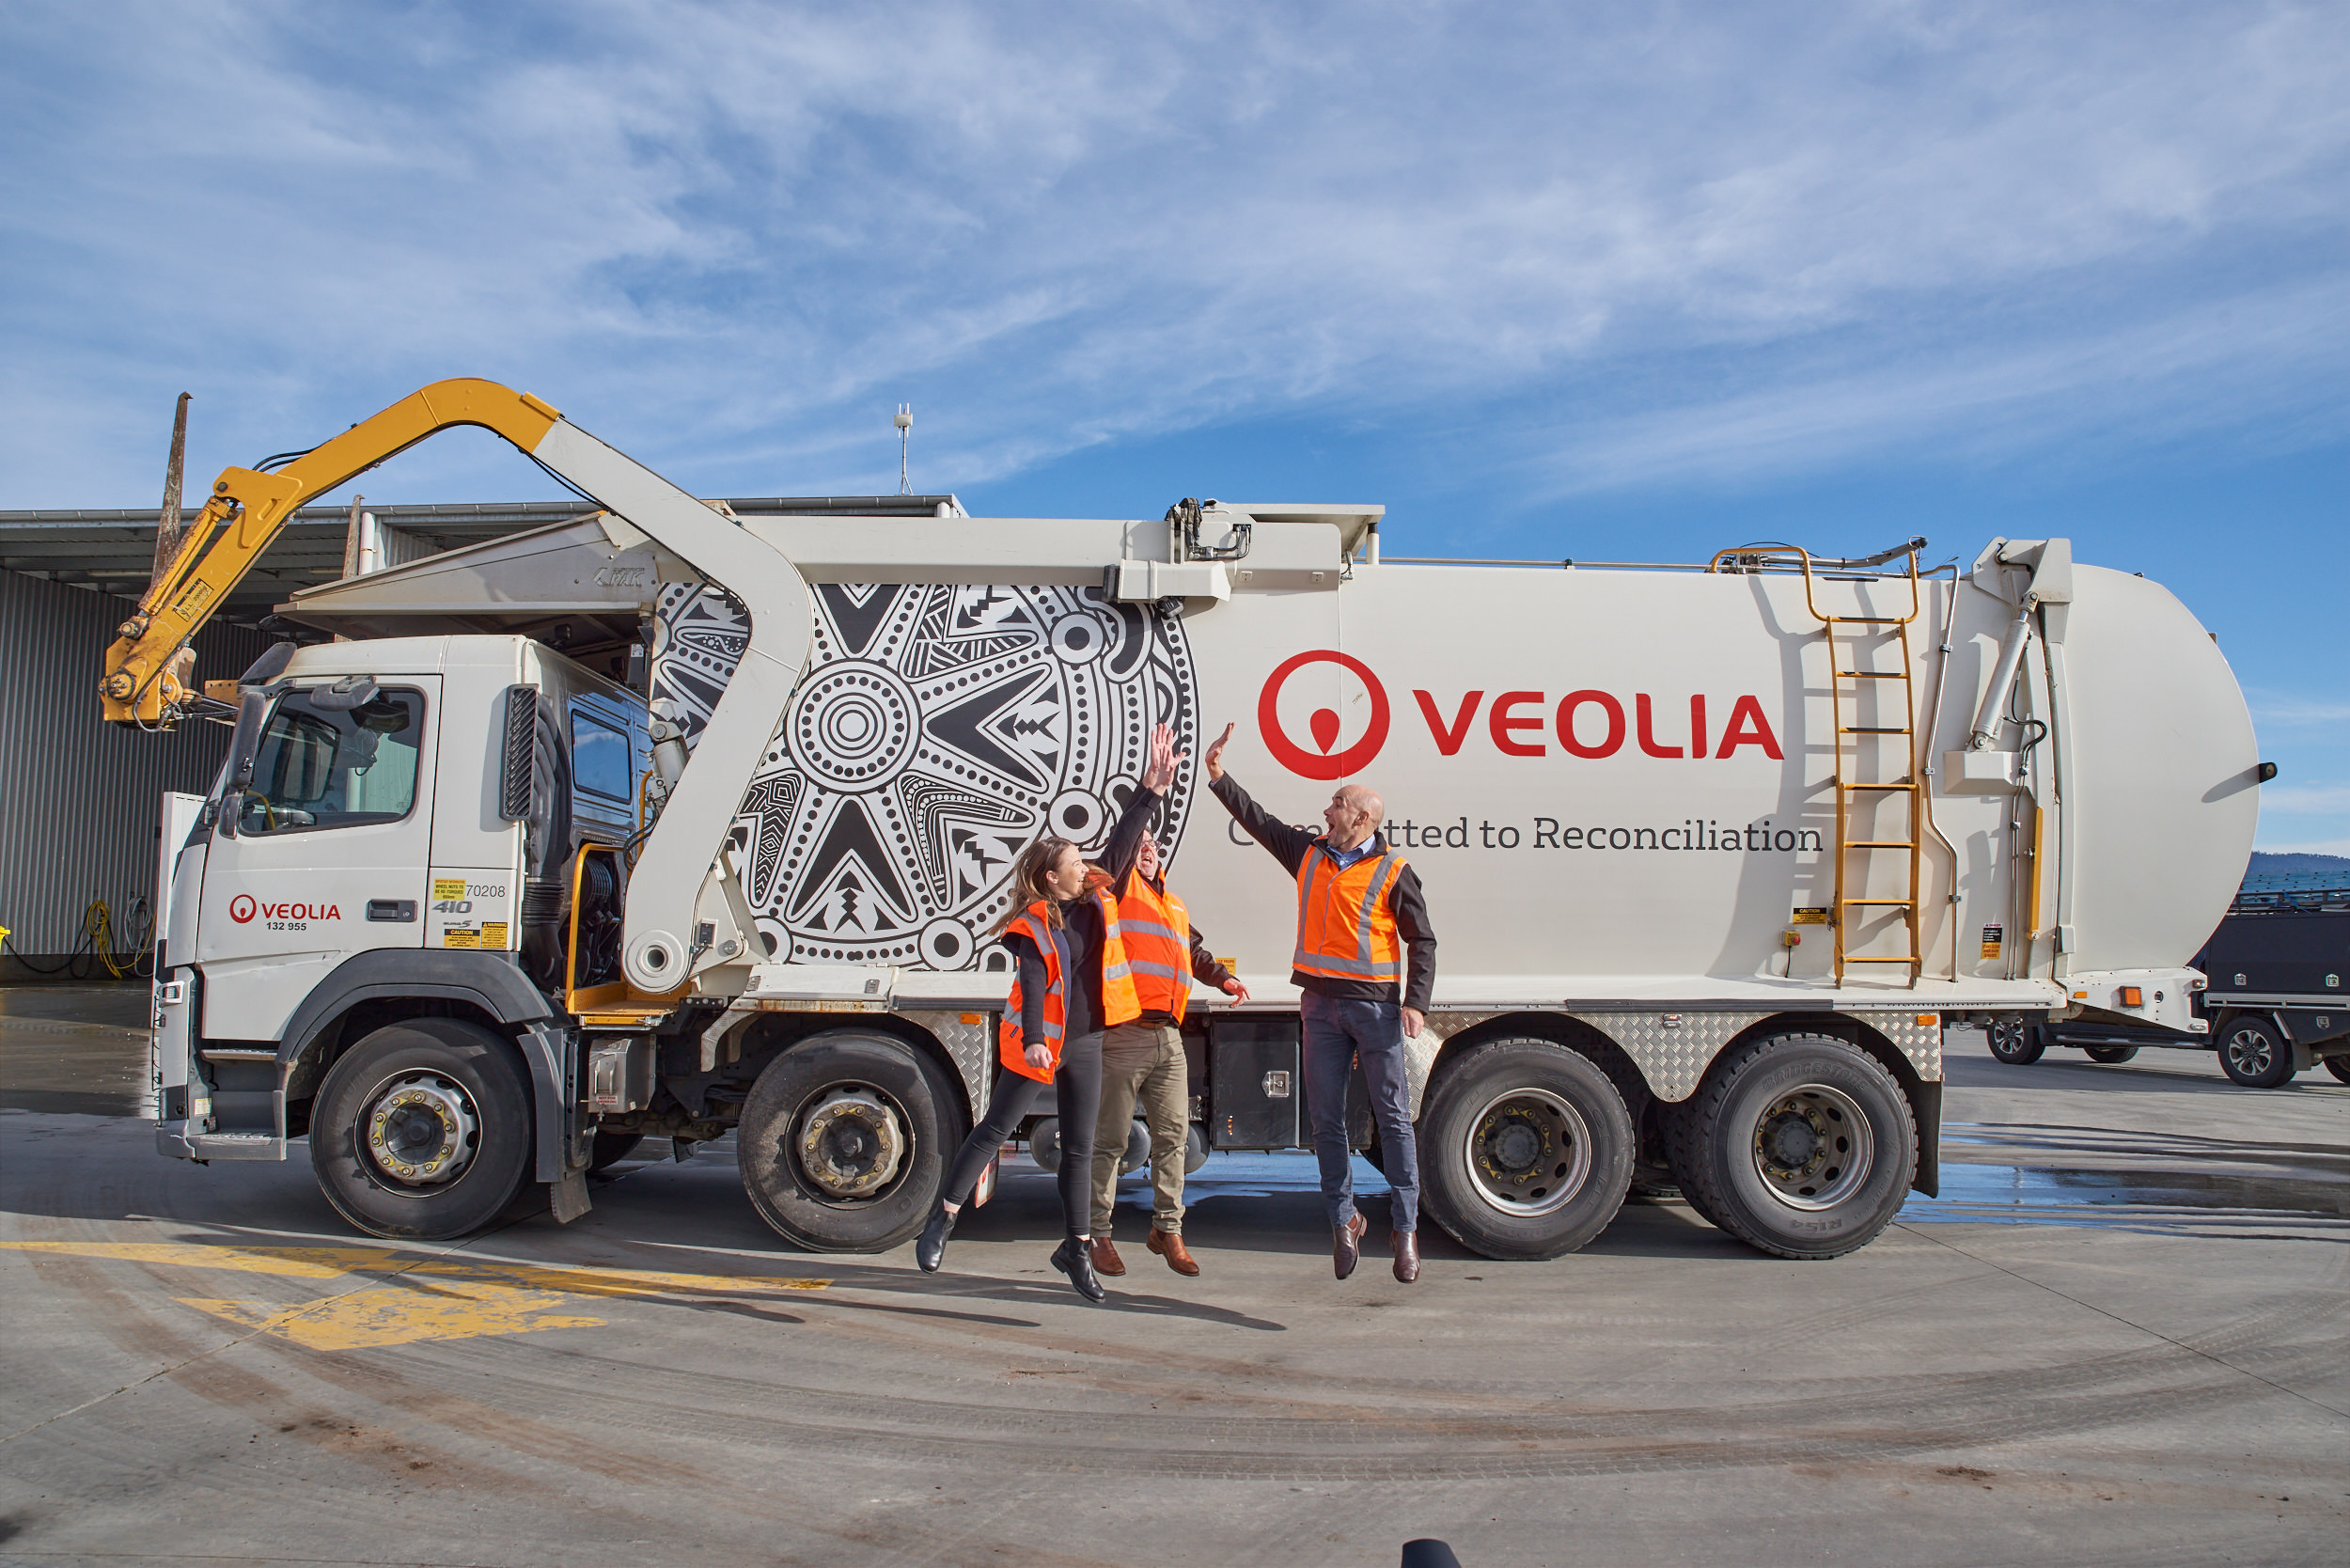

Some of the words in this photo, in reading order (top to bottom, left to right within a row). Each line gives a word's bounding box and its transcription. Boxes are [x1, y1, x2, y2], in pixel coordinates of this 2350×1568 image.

[609, 572, 645, 587] PAK
[1412, 689, 1785, 760] VEOLIA
[1228, 816, 1469, 849] Ctted
[1479, 819, 1520, 849] to
[1533, 817, 1824, 852] Reconciliation
[466, 885, 506, 898] 70208
[261, 902, 341, 920] VEOLIA
[431, 900, 473, 913] 410
[266, 921, 285, 931] 132
[288, 922, 307, 931] 955
